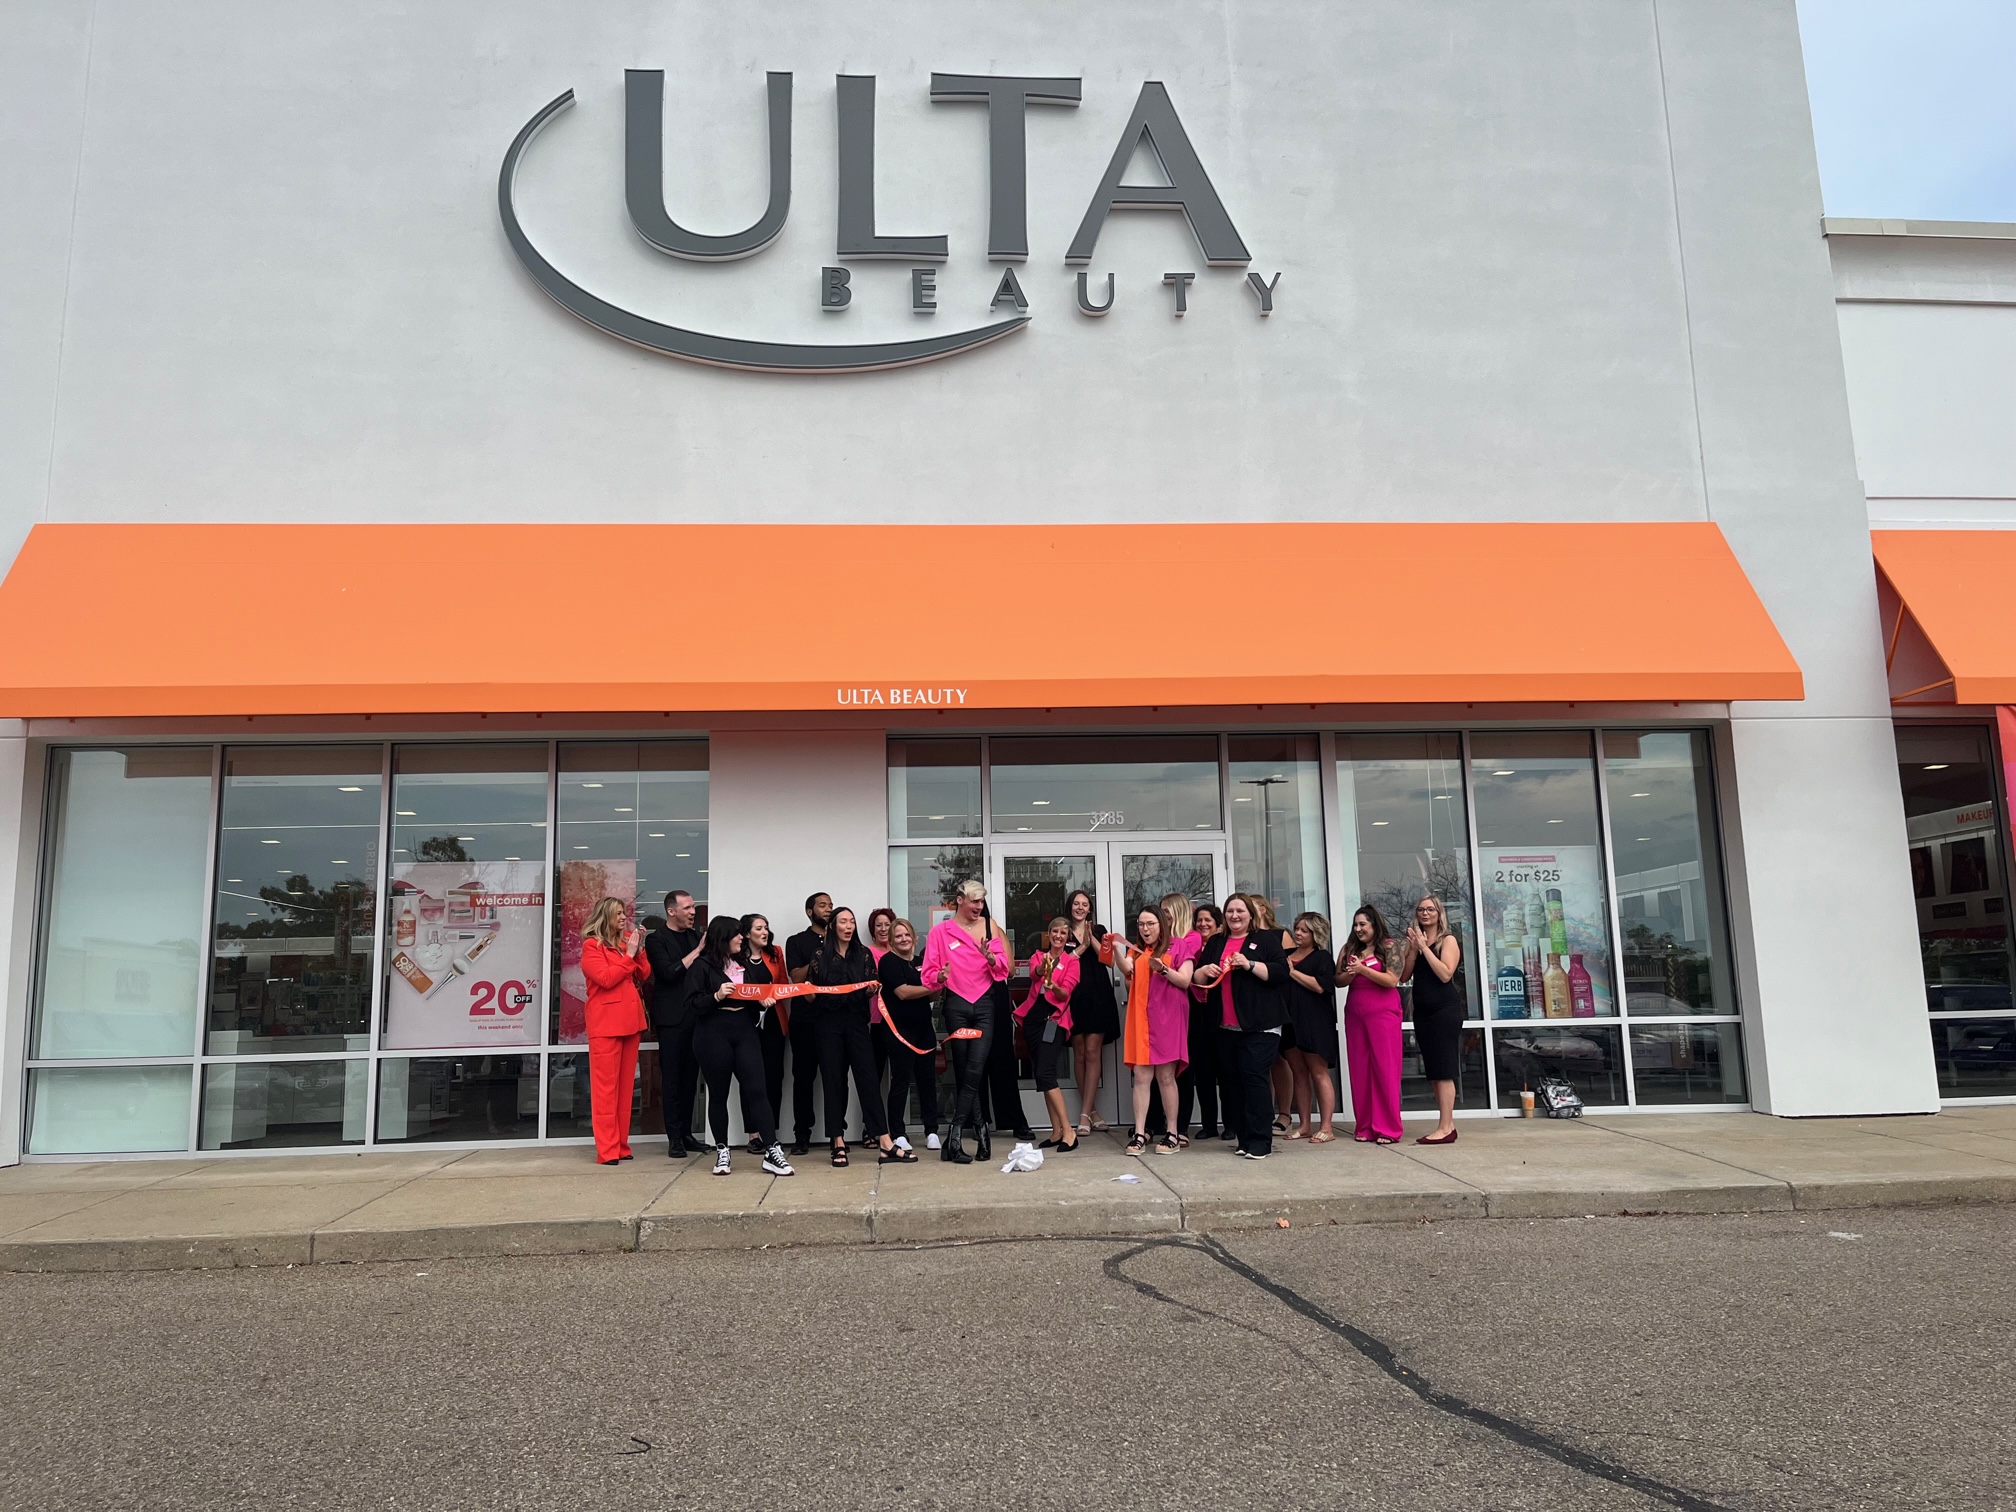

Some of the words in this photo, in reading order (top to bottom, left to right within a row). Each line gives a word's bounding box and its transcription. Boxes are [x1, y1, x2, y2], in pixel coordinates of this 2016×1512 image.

[624, 68, 1252, 265] ULTA
[821, 266, 1282, 316] BEAUTY
[837, 688, 885, 705] ULTA
[889, 688, 968, 705] BEAUTY
[364, 841, 377, 881] ORDER
[1495, 871, 1504, 883] 2
[1508, 870, 1530, 883] for
[475, 895, 529, 906] welcome
[531, 894, 543, 905] in
[741, 986, 761, 996] ULTA
[778, 985, 800, 995] ULTA
[1499, 980, 1522, 992] VERB
